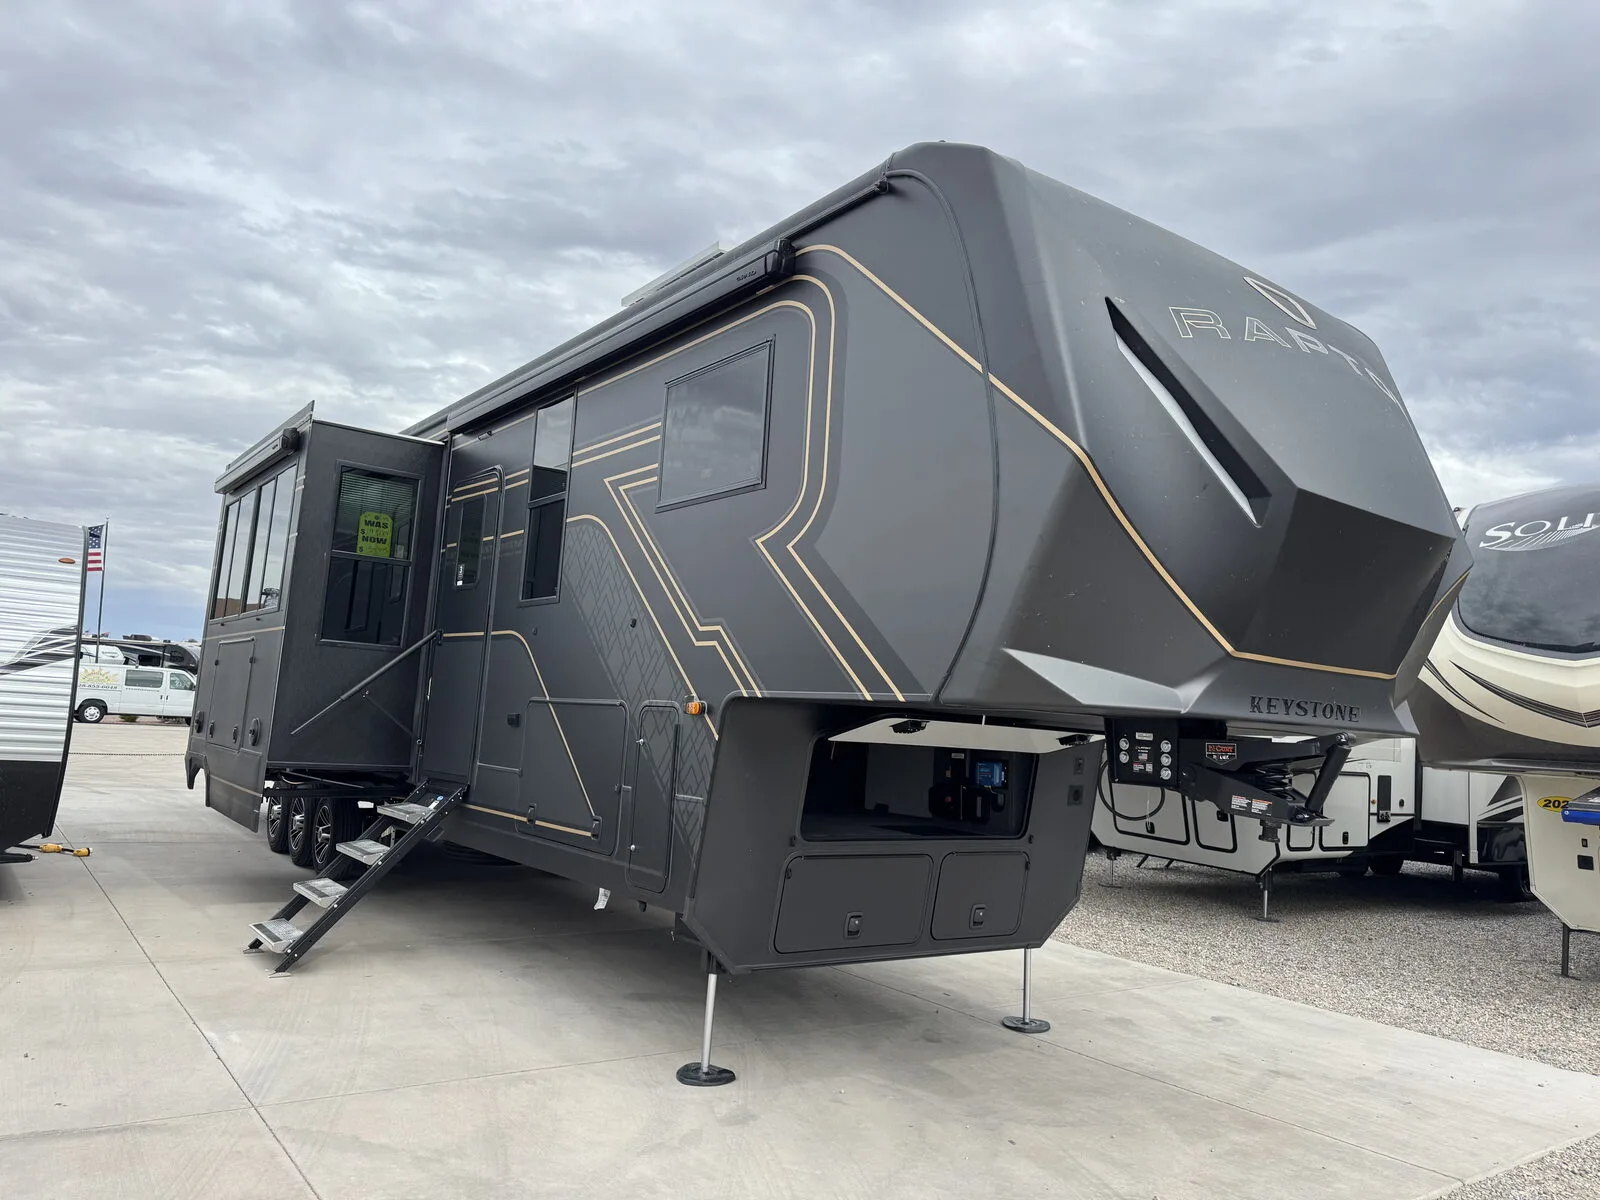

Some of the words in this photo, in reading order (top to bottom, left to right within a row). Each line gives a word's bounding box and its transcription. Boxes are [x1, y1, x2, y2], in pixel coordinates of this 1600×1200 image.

[1168, 306, 1414, 431] RAPTO
[364, 519, 389, 529] WAS
[1479, 512, 1599, 548] SOLI
[361, 535, 388, 545] NOW
[1249, 695, 1361, 723] KEYSTONE
[1542, 799, 1570, 809] 202
